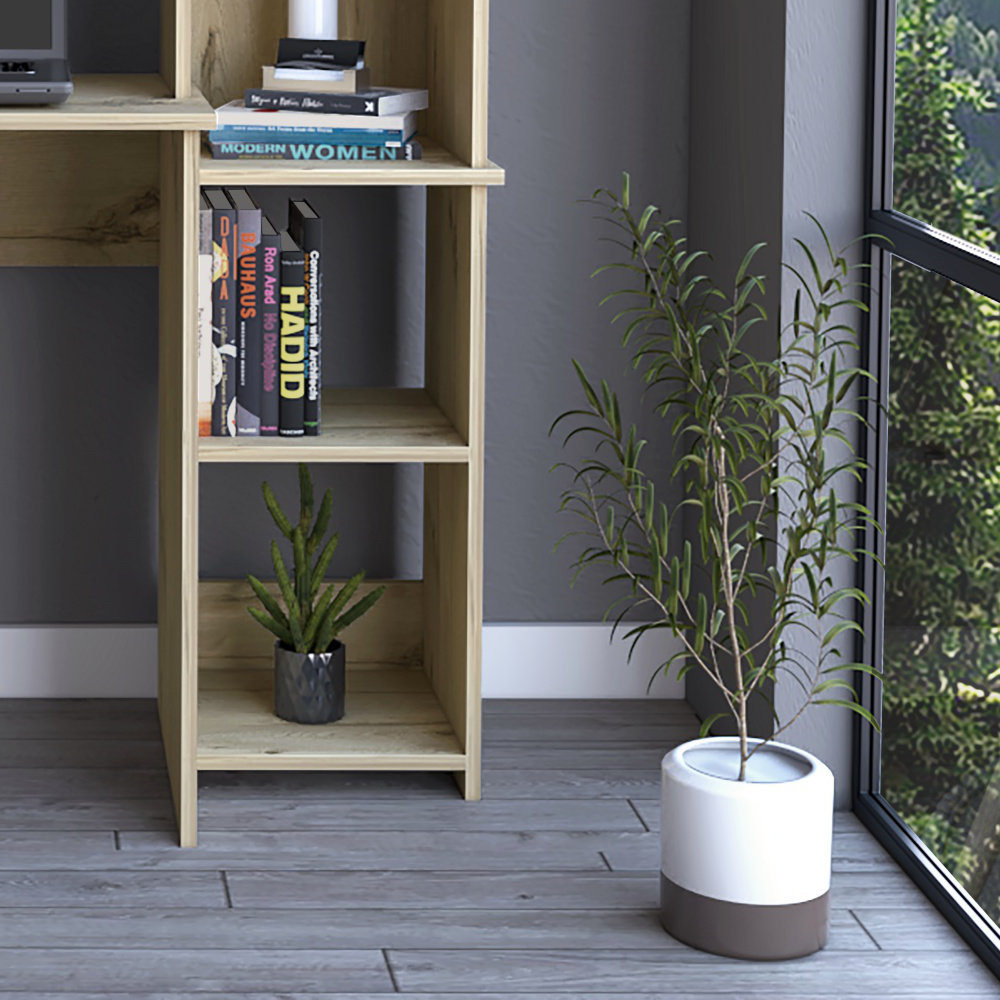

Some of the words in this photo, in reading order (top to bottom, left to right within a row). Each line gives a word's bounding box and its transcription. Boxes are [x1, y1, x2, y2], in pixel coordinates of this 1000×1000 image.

[221, 144, 286, 153] MODERN
[290, 144, 396, 160] WOMEN
[264, 247, 277, 272] Ron
[240, 232, 256, 319] BAUHAUS
[264, 275, 277, 304] Arad
[310, 250, 320, 323] Conversations
[280, 286, 304, 399] HADID
[310, 325, 319, 347] with
[308, 349, 319, 401] Architects
